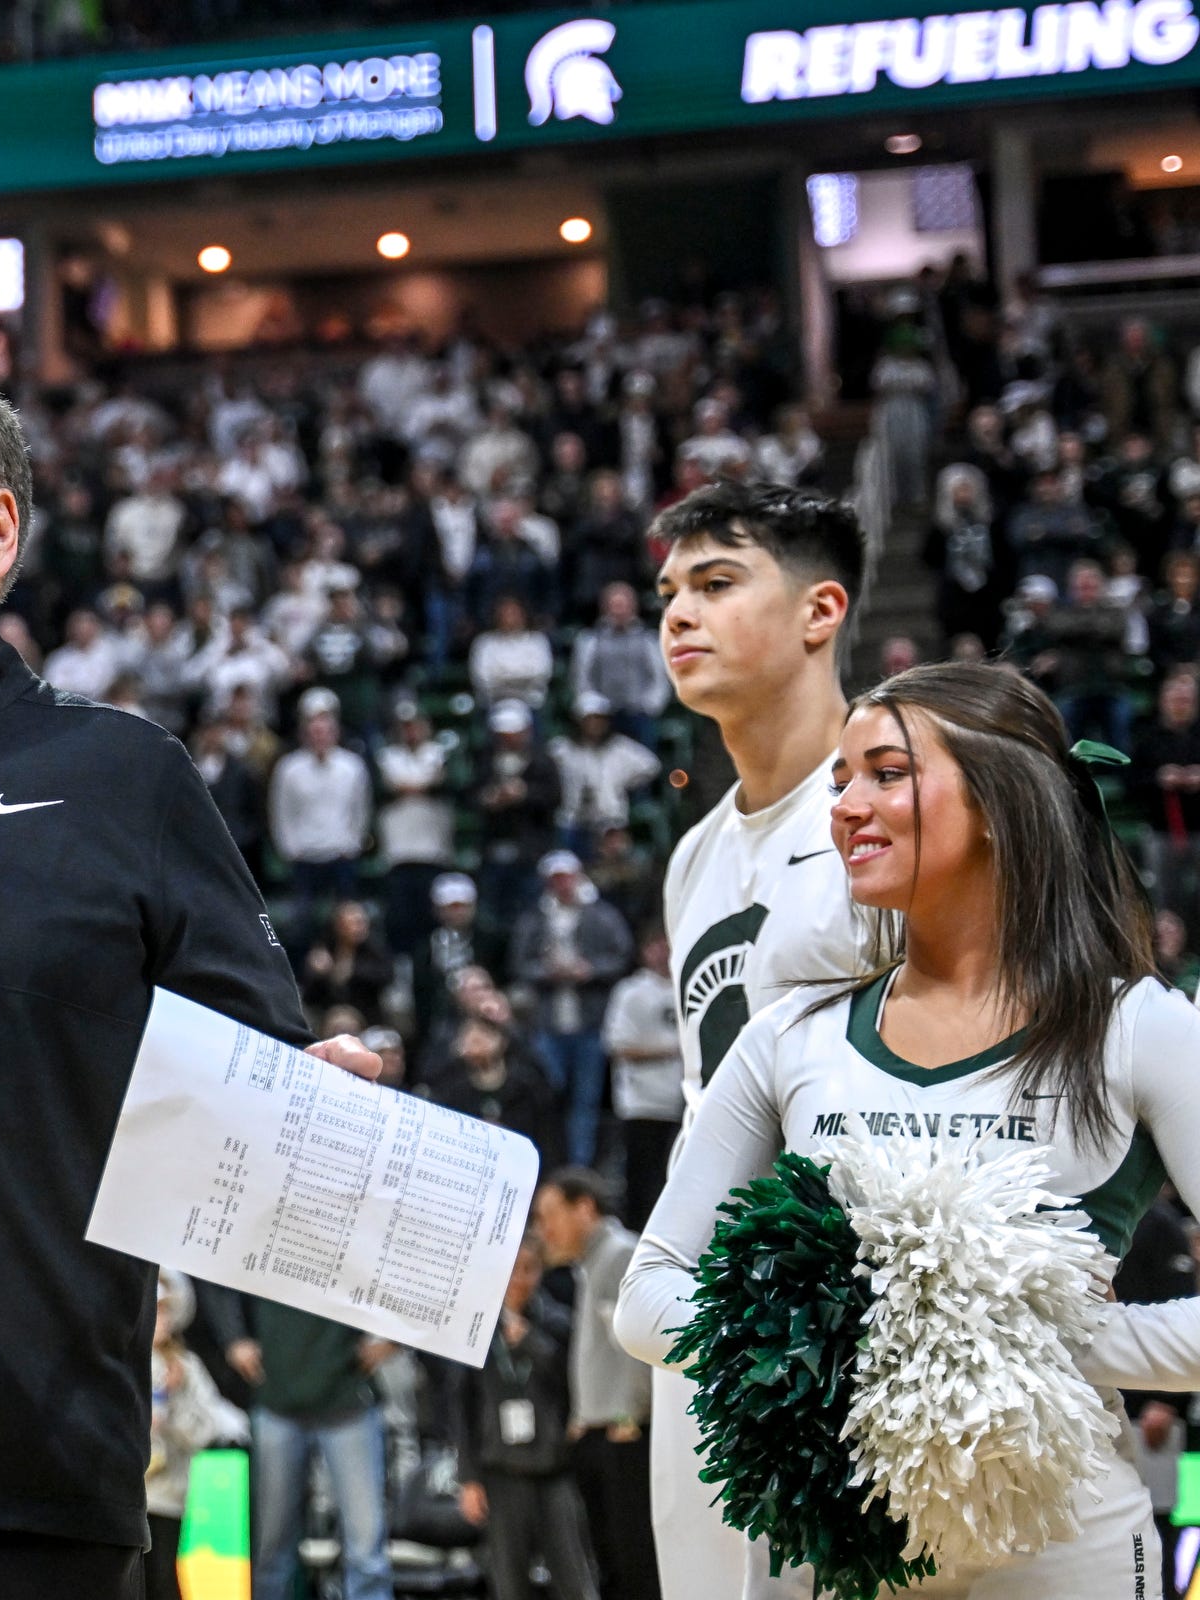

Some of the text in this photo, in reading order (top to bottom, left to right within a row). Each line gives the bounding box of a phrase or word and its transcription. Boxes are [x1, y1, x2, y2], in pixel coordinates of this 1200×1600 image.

[741, 0, 1200, 103] REFUELING
[192, 64, 323, 116] MEANS
[323, 52, 442, 105] MORE
[1132, 1533, 1145, 1573] STATE
